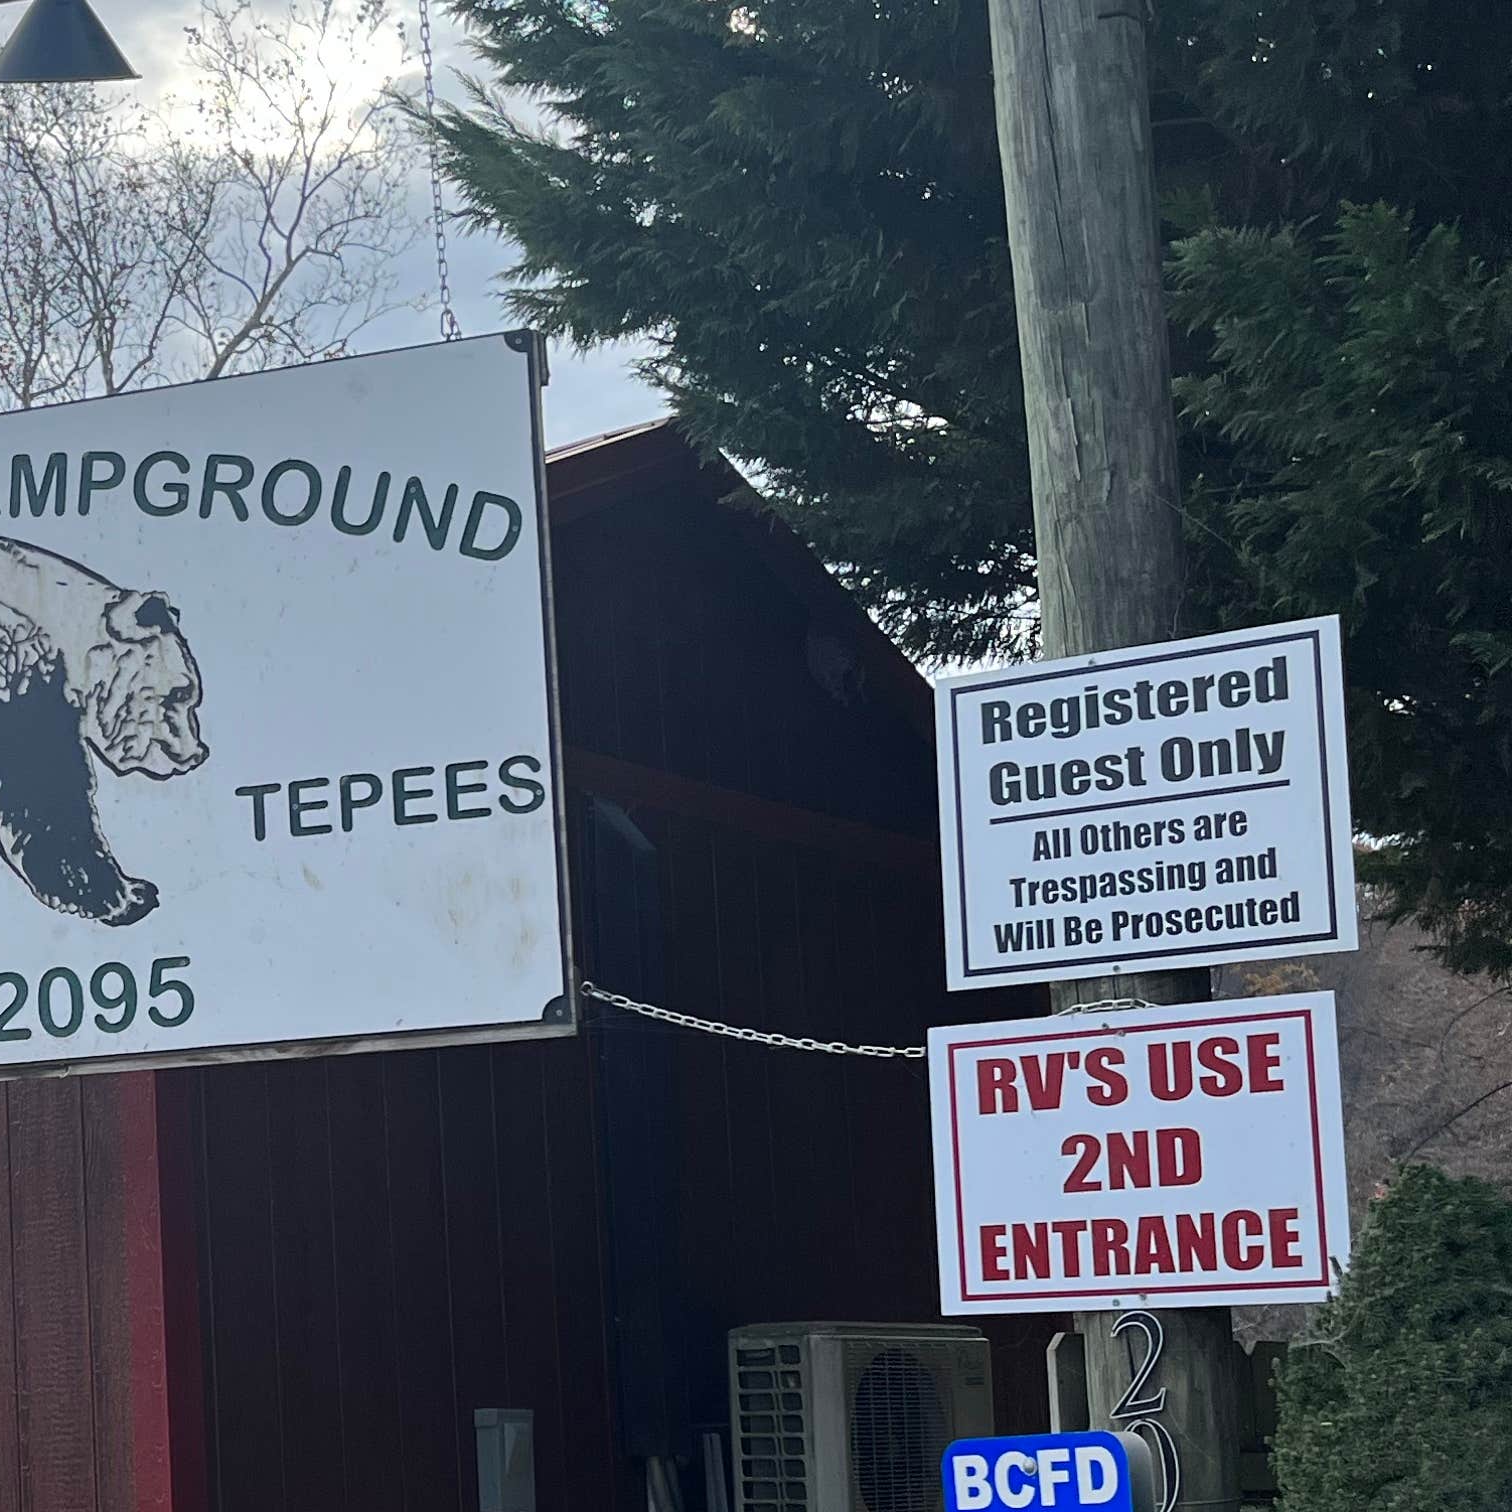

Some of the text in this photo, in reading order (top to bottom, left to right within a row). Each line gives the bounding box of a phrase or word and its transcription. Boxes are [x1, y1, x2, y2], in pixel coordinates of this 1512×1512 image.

[980, 656, 1289, 744] Registered
[235, 756, 545, 841] TEPEES
[989, 728, 1286, 806] Guest Only
[1032, 811, 1248, 861] All Others are
[1009, 847, 1278, 908] Trespassing and
[994, 891, 1301, 954] Will Be Prosecuted
[976, 1032, 1285, 1115] RV'S USE
[1060, 1127, 1202, 1193] 2ND
[979, 1207, 1303, 1282] ENTRANCE
[951, 1445, 1119, 1512] BCFD
